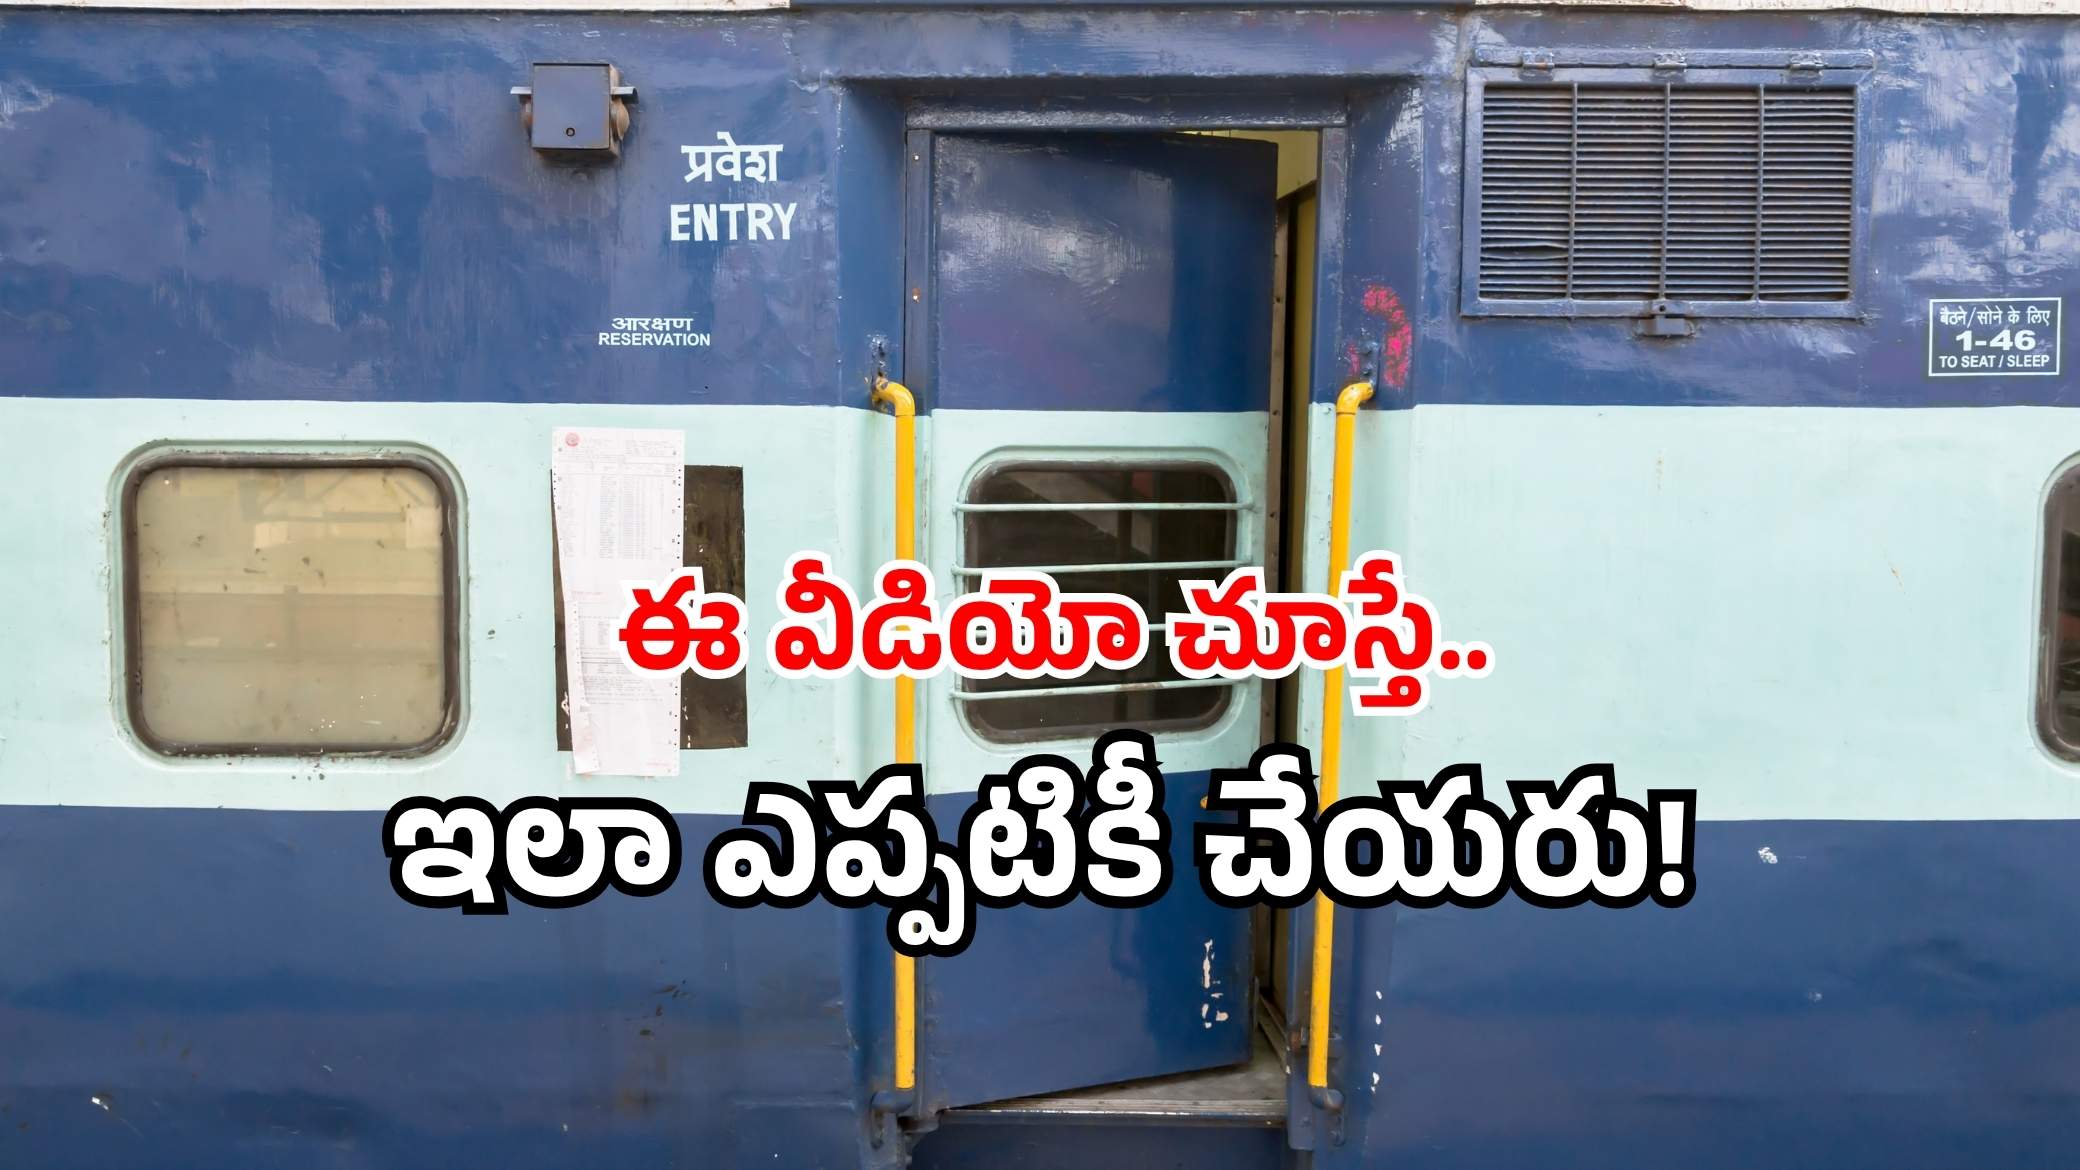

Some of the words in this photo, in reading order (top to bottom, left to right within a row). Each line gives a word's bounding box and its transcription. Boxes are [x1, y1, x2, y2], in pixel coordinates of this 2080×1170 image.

[680, 131, 784, 183] प्रवेश
[670, 202, 798, 241] ENTRY
[611, 317, 694, 332] आरक्षण
[2007, 305, 2021, 324] के
[2026, 305, 2051, 327] लिए
[598, 332, 711, 346] RESERVATION
[1955, 329, 2036, 351] 1-46
[1938, 355, 1958, 368] TO
[1961, 355, 1997, 368] SEAT
[2007, 354, 2050, 368] SLEEP
